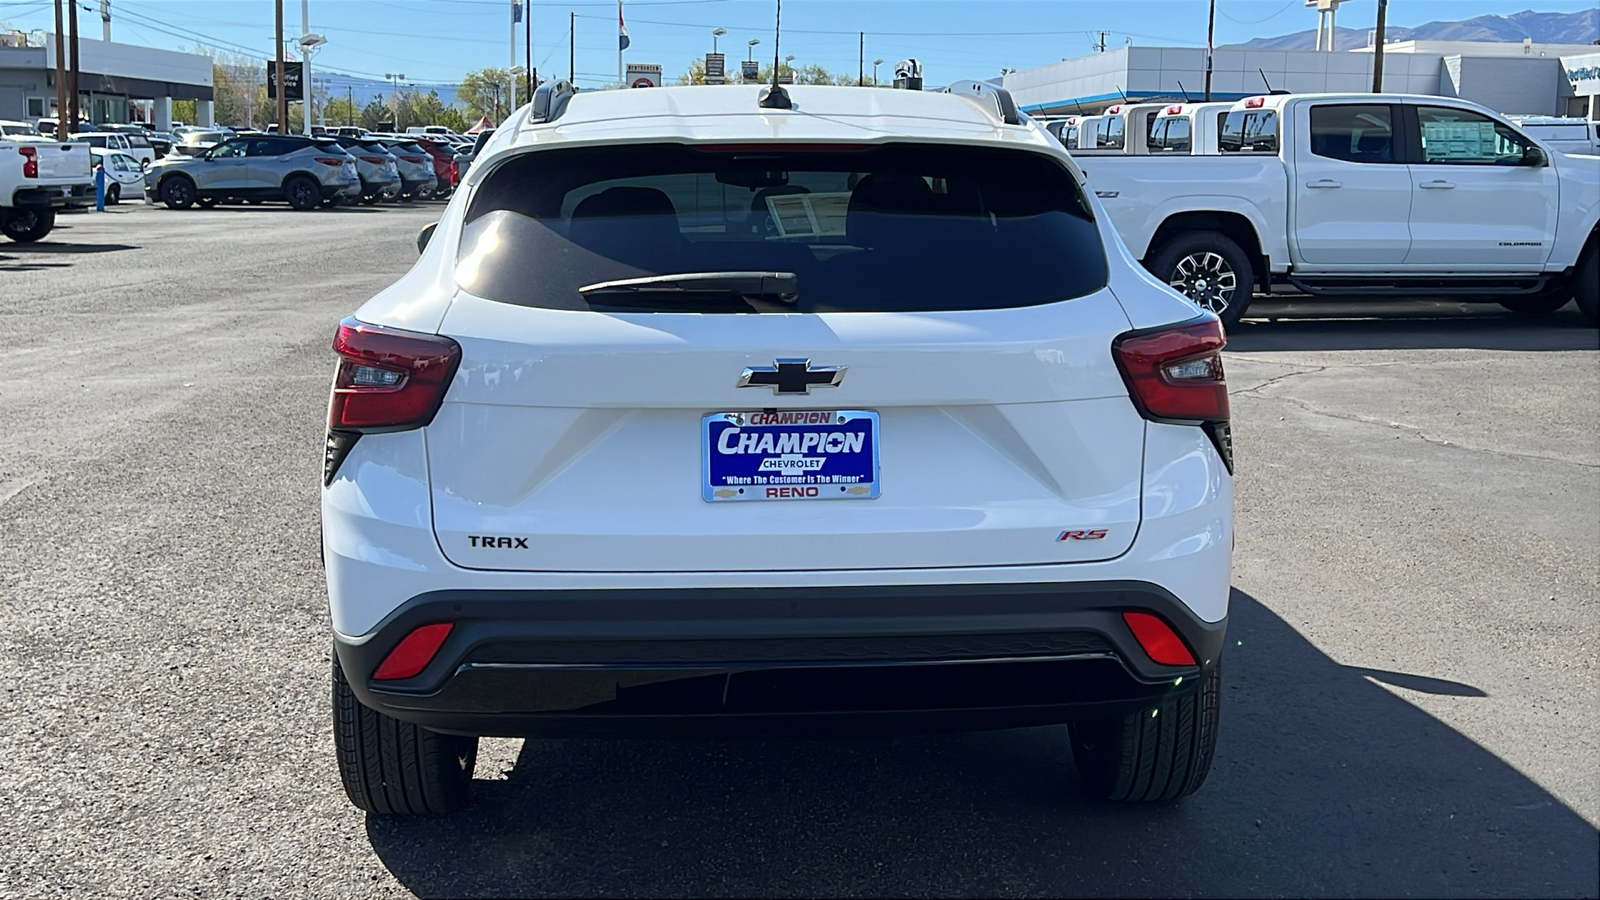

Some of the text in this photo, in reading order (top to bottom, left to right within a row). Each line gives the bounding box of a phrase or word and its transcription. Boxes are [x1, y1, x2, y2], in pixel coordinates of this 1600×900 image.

[750, 412, 832, 425] CHAMPION
[717, 427, 865, 455] CHAMPION
[763, 459, 821, 469] CHEVROLET
[753, 475, 768, 484] The
[769, 475, 806, 484] Customer
[807, 475, 815, 483] Is
[816, 475, 831, 483] The
[765, 487, 819, 498] RENO
[1055, 528, 1109, 542] RS
[468, 535, 529, 549] TRAX
